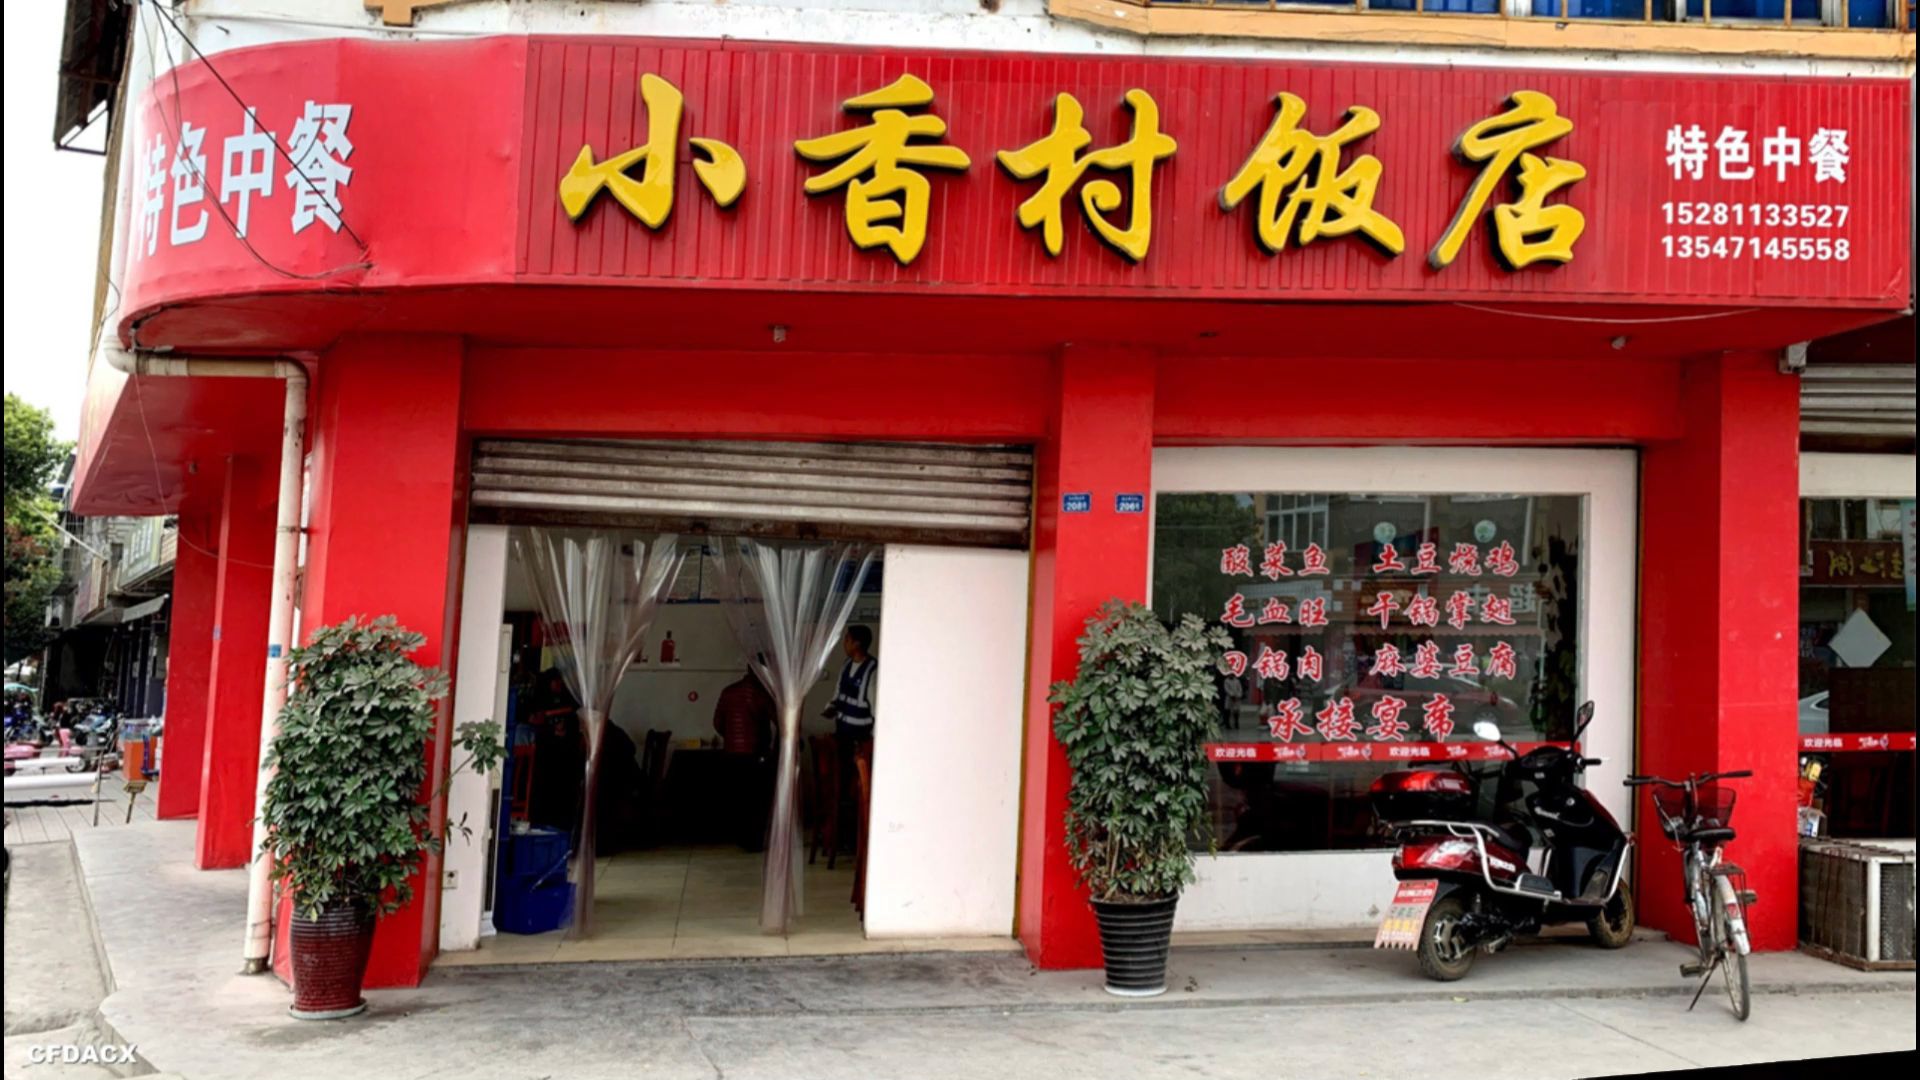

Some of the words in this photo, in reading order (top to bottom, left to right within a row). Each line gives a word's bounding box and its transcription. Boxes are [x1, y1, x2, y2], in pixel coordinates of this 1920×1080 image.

[559, 73, 1586, 268] 小香村饭店
[1665, 124, 1850, 183] 特色中餐
[137, 100, 354, 262] 特色中餐
[1661, 202, 1850, 228] 15281133527
[1661, 235, 1850, 261] 13547145558
[1221, 540, 1330, 580] 酸菜鱼
[1373, 540, 1519, 577] 土豆烧鸡
[1221, 593, 1329, 627] 毛血旺
[1367, 591, 1517, 630] 干锅掌翅
[1218, 645, 1323, 682] 回锅肉
[1369, 640, 1517, 680] 麻婆豆腐
[1268, 693, 1455, 742] 承接宴席
[1215, 747, 1257, 758] 欢迎光临
